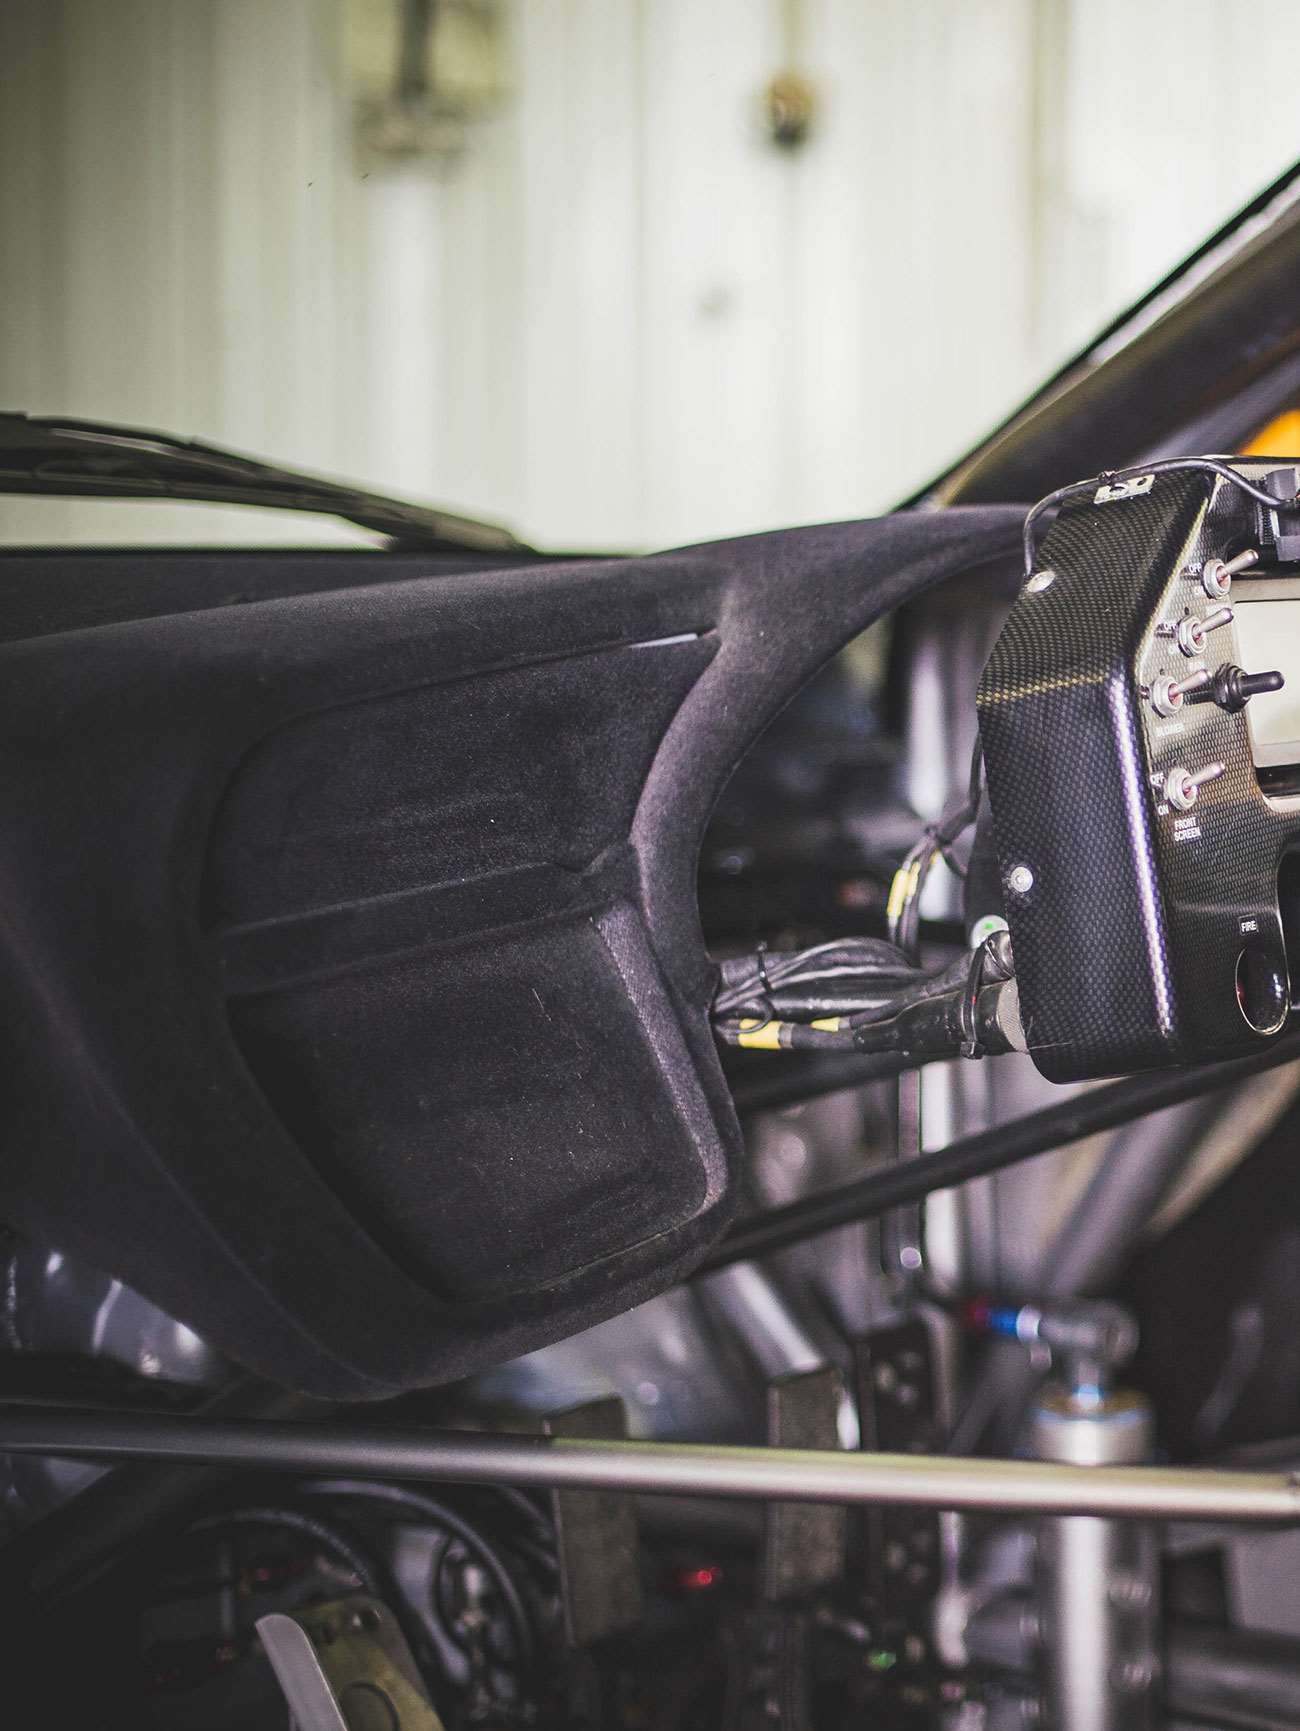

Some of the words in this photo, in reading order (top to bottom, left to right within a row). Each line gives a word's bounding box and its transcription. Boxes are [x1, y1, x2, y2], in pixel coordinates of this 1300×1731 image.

[1150, 772, 1165, 785] OFF
[1157, 804, 1169, 815] ON
[1174, 816, 1197, 830] FRONT
[1174, 827, 1201, 842] SCREEN
[1241, 920, 1257, 933] FIRE
